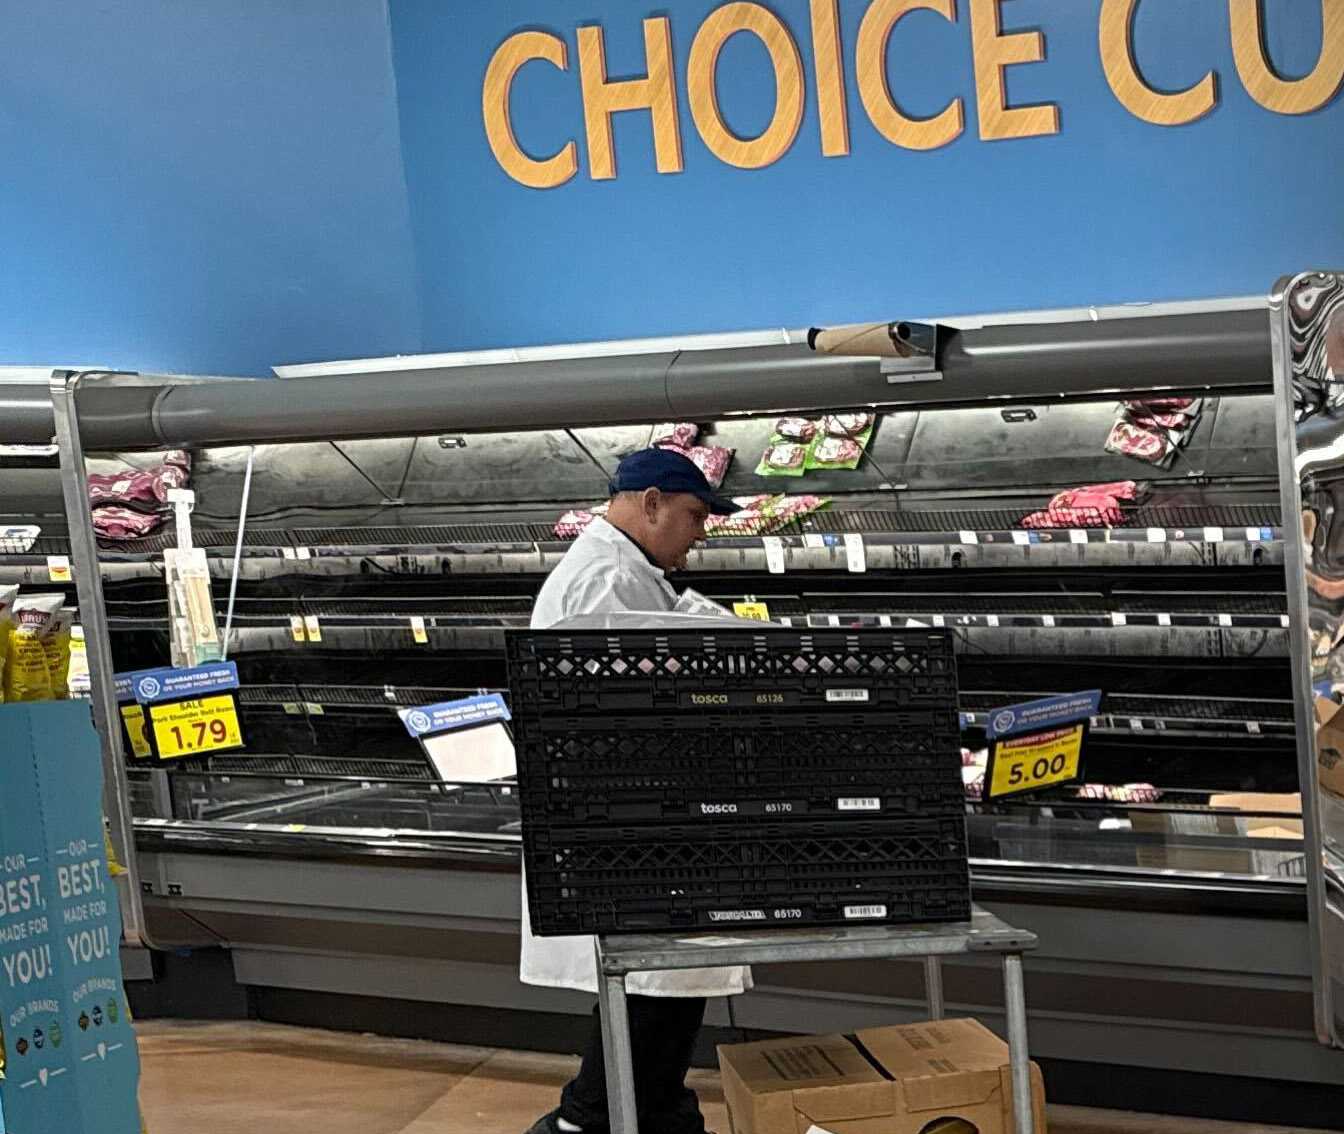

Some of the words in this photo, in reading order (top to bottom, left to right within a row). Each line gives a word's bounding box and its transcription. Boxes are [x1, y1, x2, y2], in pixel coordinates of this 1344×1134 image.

[482, 0, 1060, 189] CHOICE
[179, 700, 205, 711] SALE
[690, 692, 729, 704] tosca
[170, 718, 228, 751] 1.79
[1008, 753, 1067, 786] 5.00
[700, 802, 738, 814] tosca
[69, 839, 88, 857] OUR
[4, 856, 26, 874] OUR
[57, 859, 105, 900] BEST,
[67, 925, 112, 966] YOU!
[3, 944, 53, 987] YOU!
